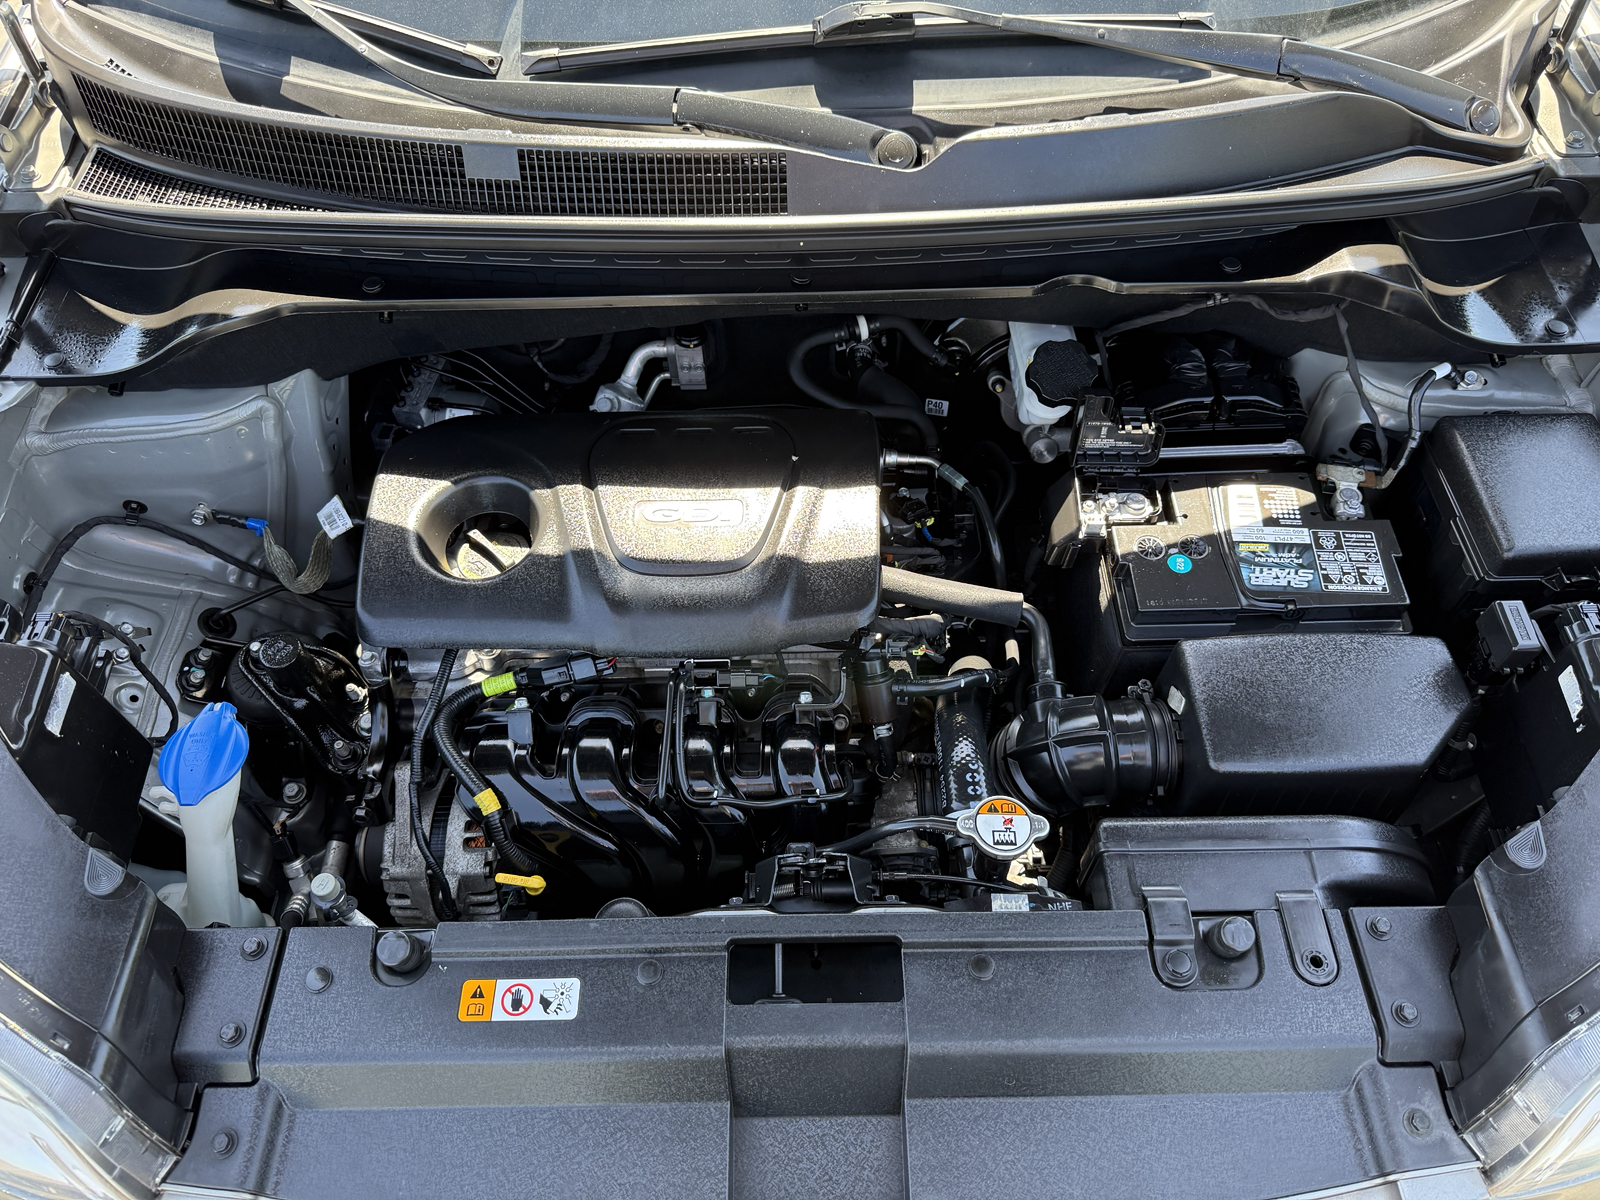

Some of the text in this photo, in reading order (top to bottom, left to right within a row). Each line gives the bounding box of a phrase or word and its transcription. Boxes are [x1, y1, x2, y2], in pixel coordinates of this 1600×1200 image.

[927, 400, 944, 410] P40
[642, 507, 732, 523] GDI
[1254, 556, 1303, 564] PLATINUM
[1249, 567, 1314, 581] START
[1250, 575, 1309, 588] SUPER
